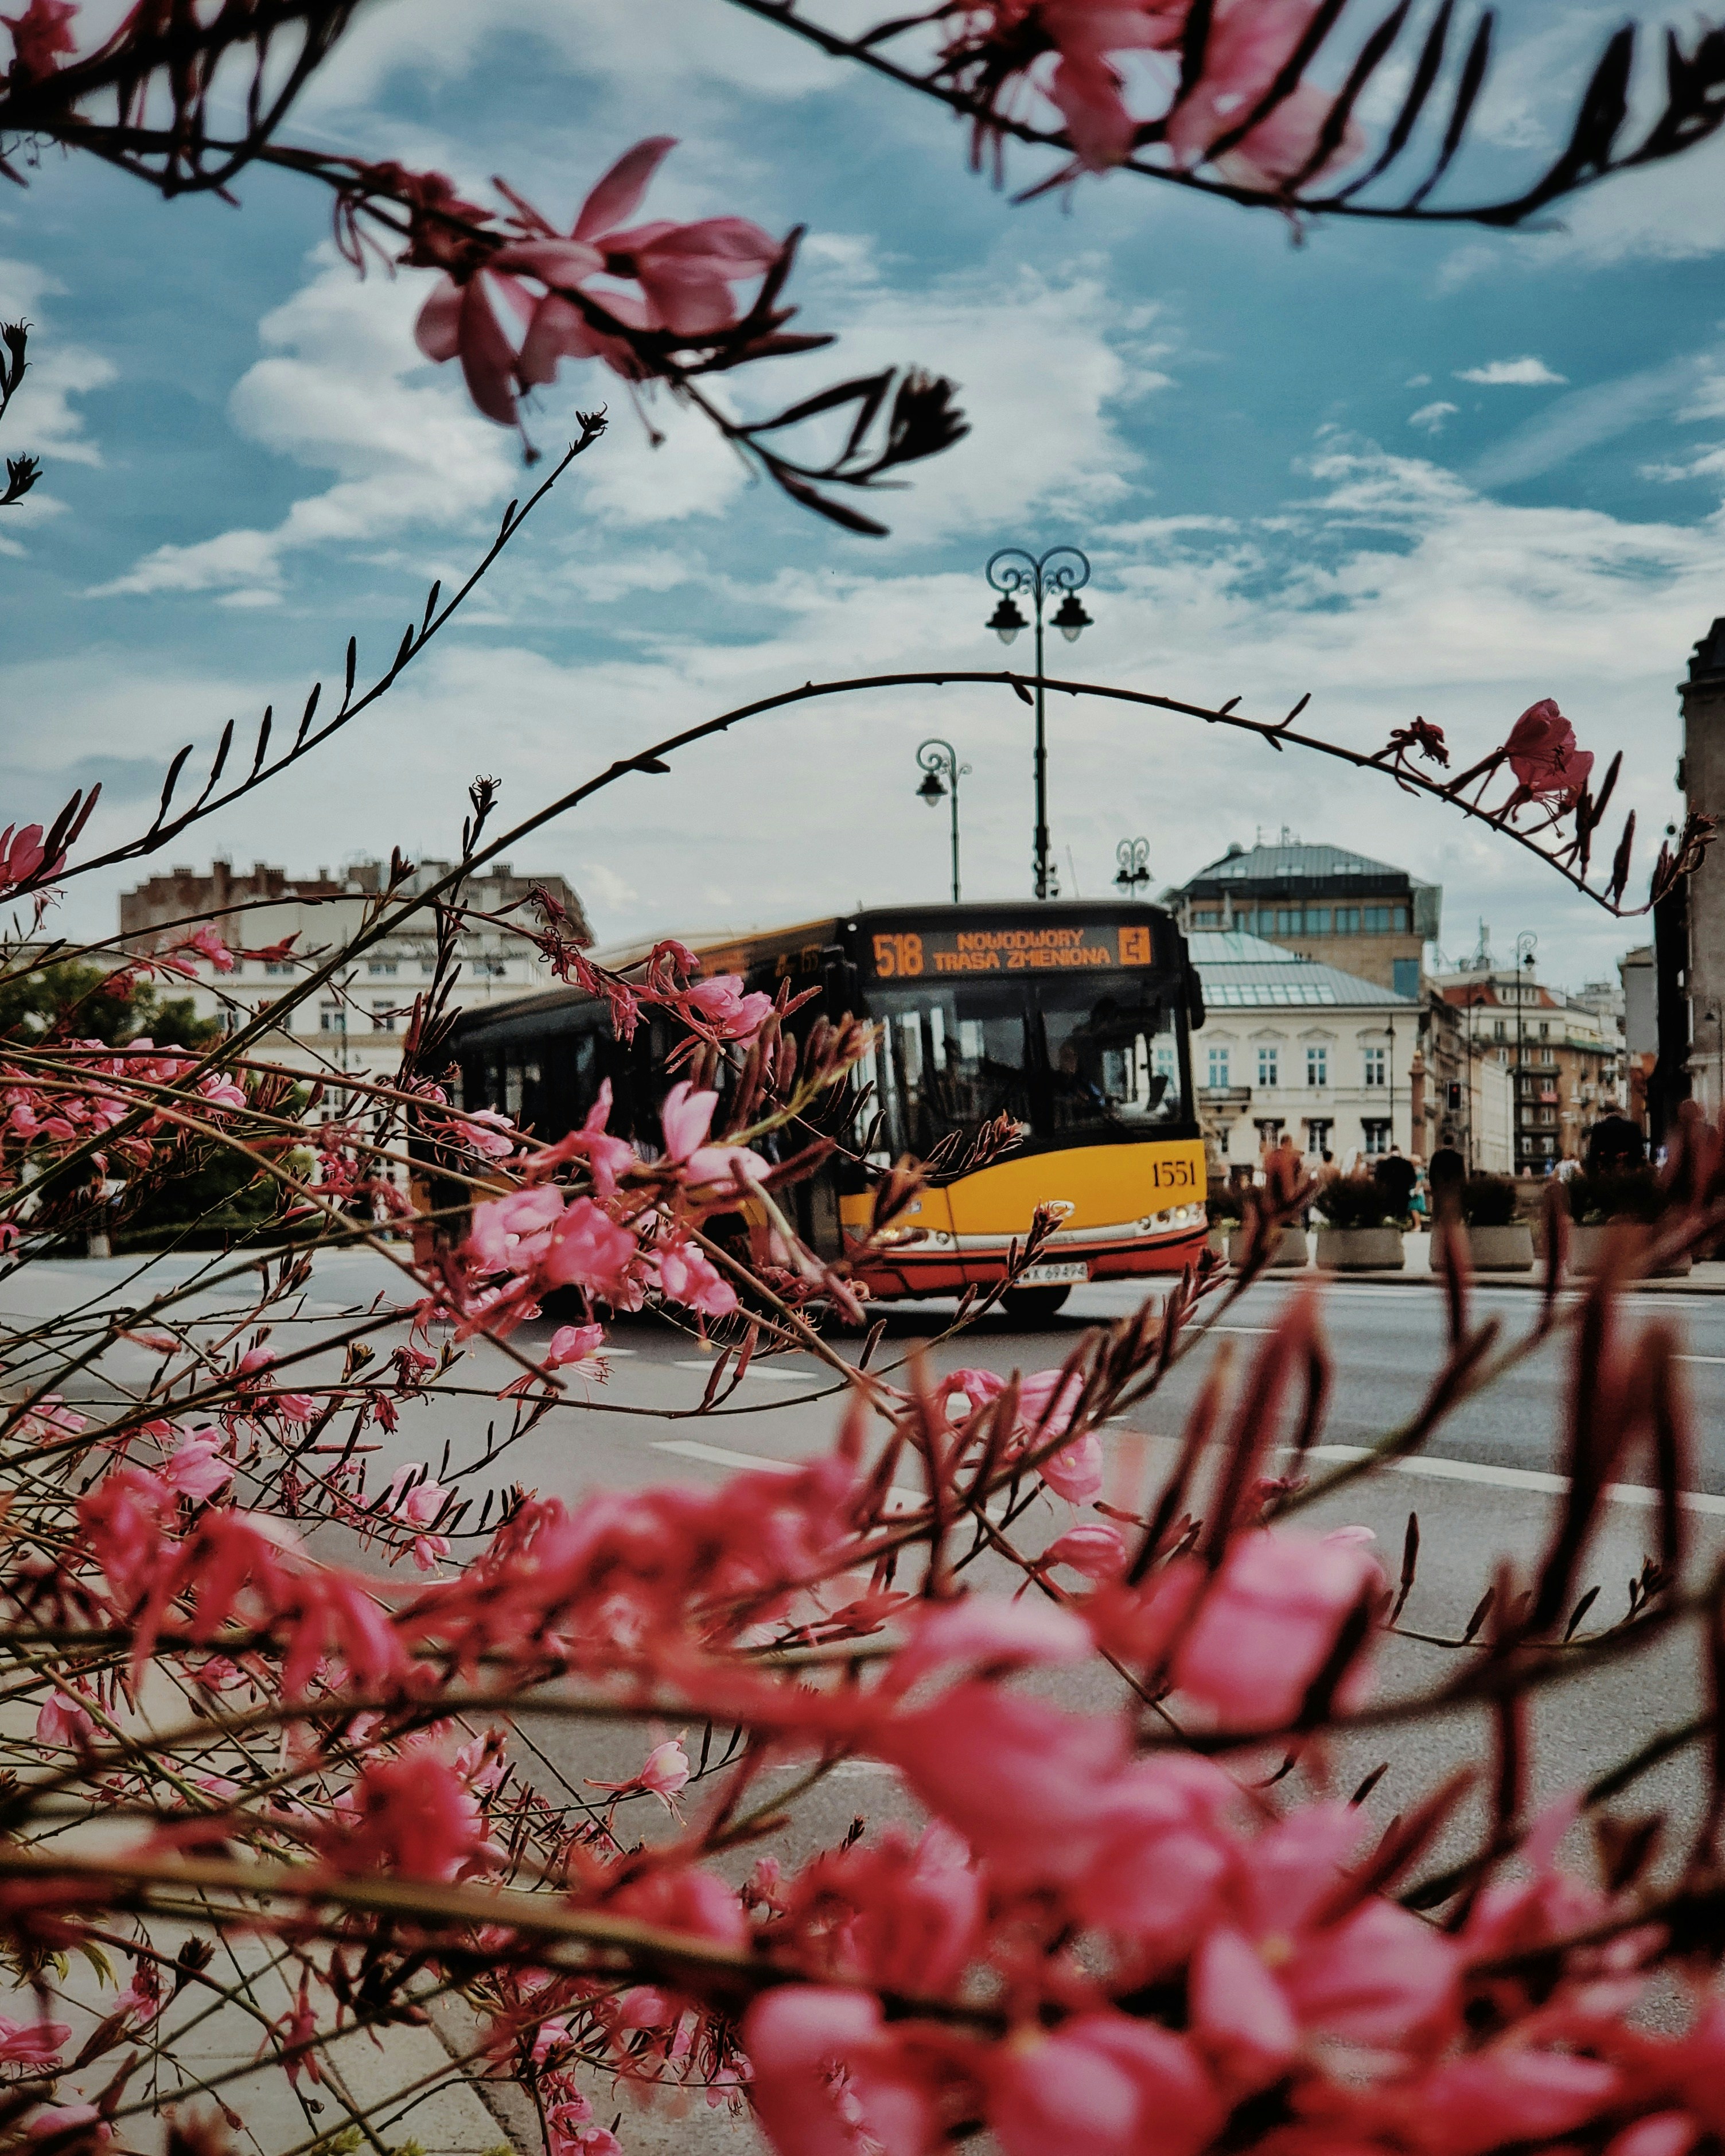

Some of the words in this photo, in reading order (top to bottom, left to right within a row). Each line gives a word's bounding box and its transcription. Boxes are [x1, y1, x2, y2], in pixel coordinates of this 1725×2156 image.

[957, 929, 1084, 951] NOWODWORY
[872, 933, 923, 977] 518
[933, 950, 1000, 971] TRASA
[1153, 1160, 1195, 1187] 1551
